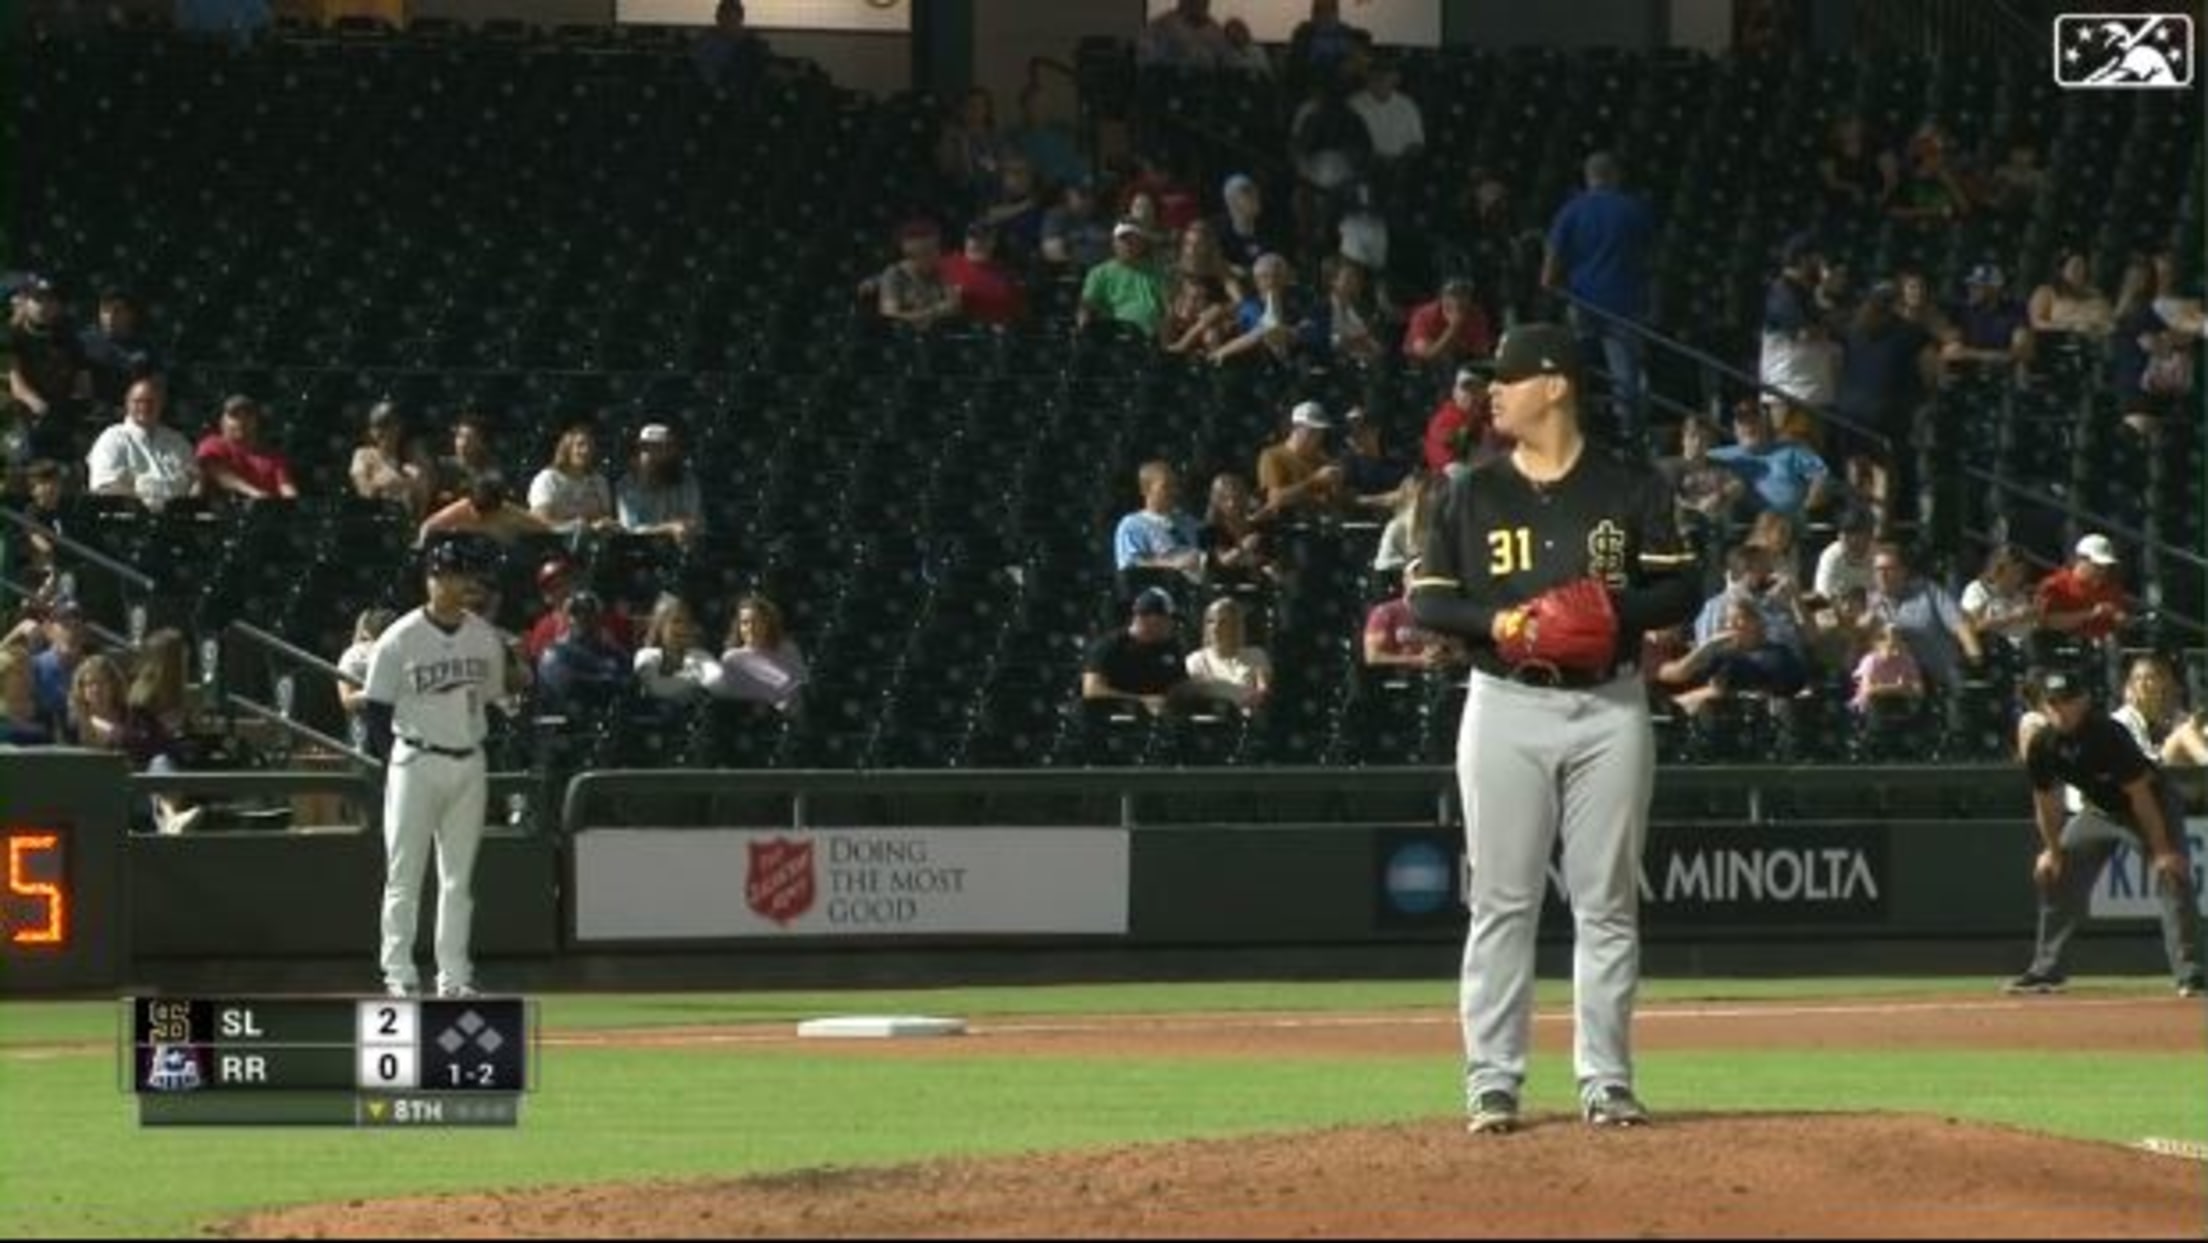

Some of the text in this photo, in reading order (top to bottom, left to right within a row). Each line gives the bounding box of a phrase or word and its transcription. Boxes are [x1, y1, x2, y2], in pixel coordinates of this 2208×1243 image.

[1488, 527, 1532, 574] 31
[10, 836, 61, 941] 5
[830, 869, 881, 892] THE
[890, 868, 966, 892] MOST
[1665, 850, 1878, 900] MINOLTA
[827, 898, 916, 924] GOOD
